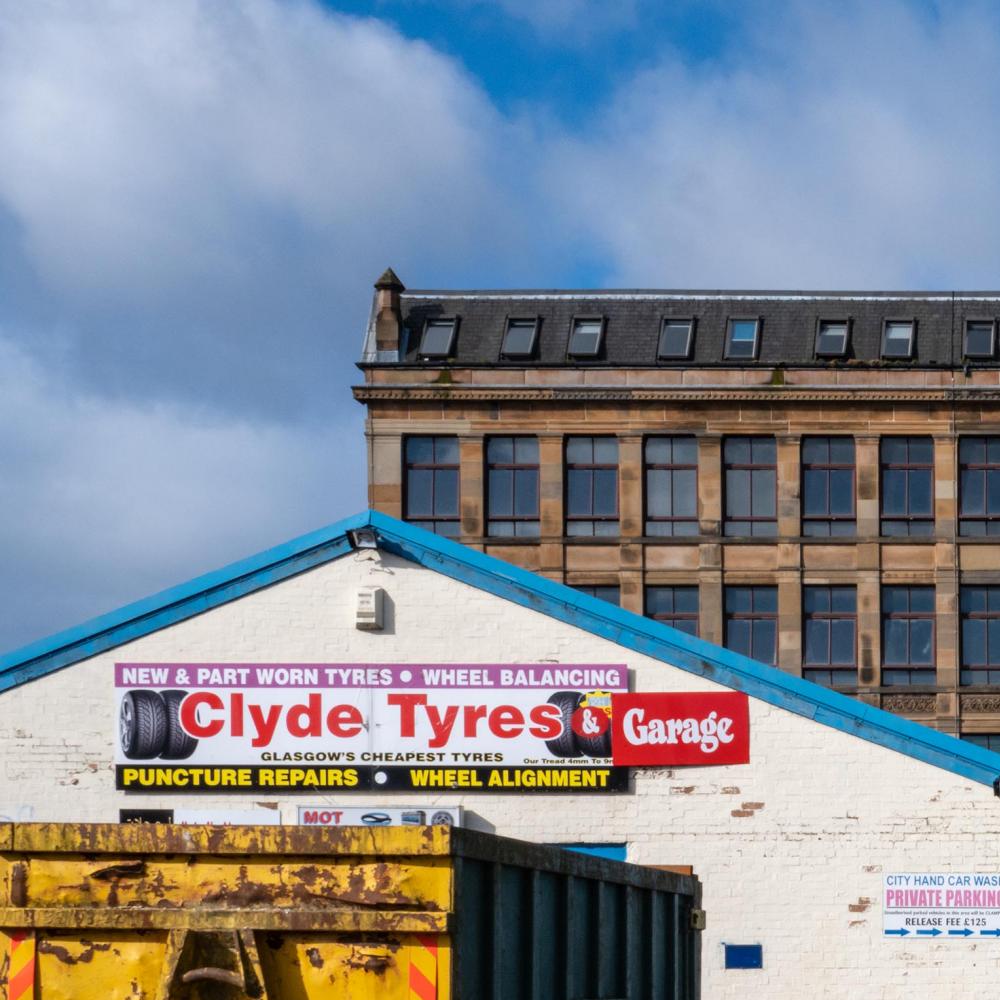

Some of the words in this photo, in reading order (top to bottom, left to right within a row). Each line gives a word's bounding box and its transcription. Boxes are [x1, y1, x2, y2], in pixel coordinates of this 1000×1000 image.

[122, 668, 169, 685] NEW
[175, 668, 190, 685] &
[197, 668, 250, 685] PART
[256, 668, 319, 685] WORN
[324, 668, 393, 686] TYRES
[422, 669, 494, 686] WHEEL
[500, 669, 621, 686] BALANCING
[180, 691, 364, 748] Clyde
[387, 693, 563, 748] Tyres
[581, 708, 600, 735] &
[623, 707, 735, 753] Garage
[261, 752, 356, 762] GLASGOW'S
[360, 752, 446, 762] CHEAPEST
[451, 752, 504, 762] TYRES
[123, 768, 252, 786] PUNCTURE
[258, 768, 359, 786] REPAIRS
[409, 769, 483, 787] WHEEL
[488, 769, 611, 787] ALIGNMENT
[303, 810, 343, 825] MOT
[886, 875, 911, 886] CITY
[914, 875, 945, 886] HAND
[948, 875, 971, 886] CAR
[886, 889, 942, 907] PRIVATE
[905, 918, 943, 926] RELEASE
[946, 918, 961, 926] FEE
[964, 918, 987, 926] £125
